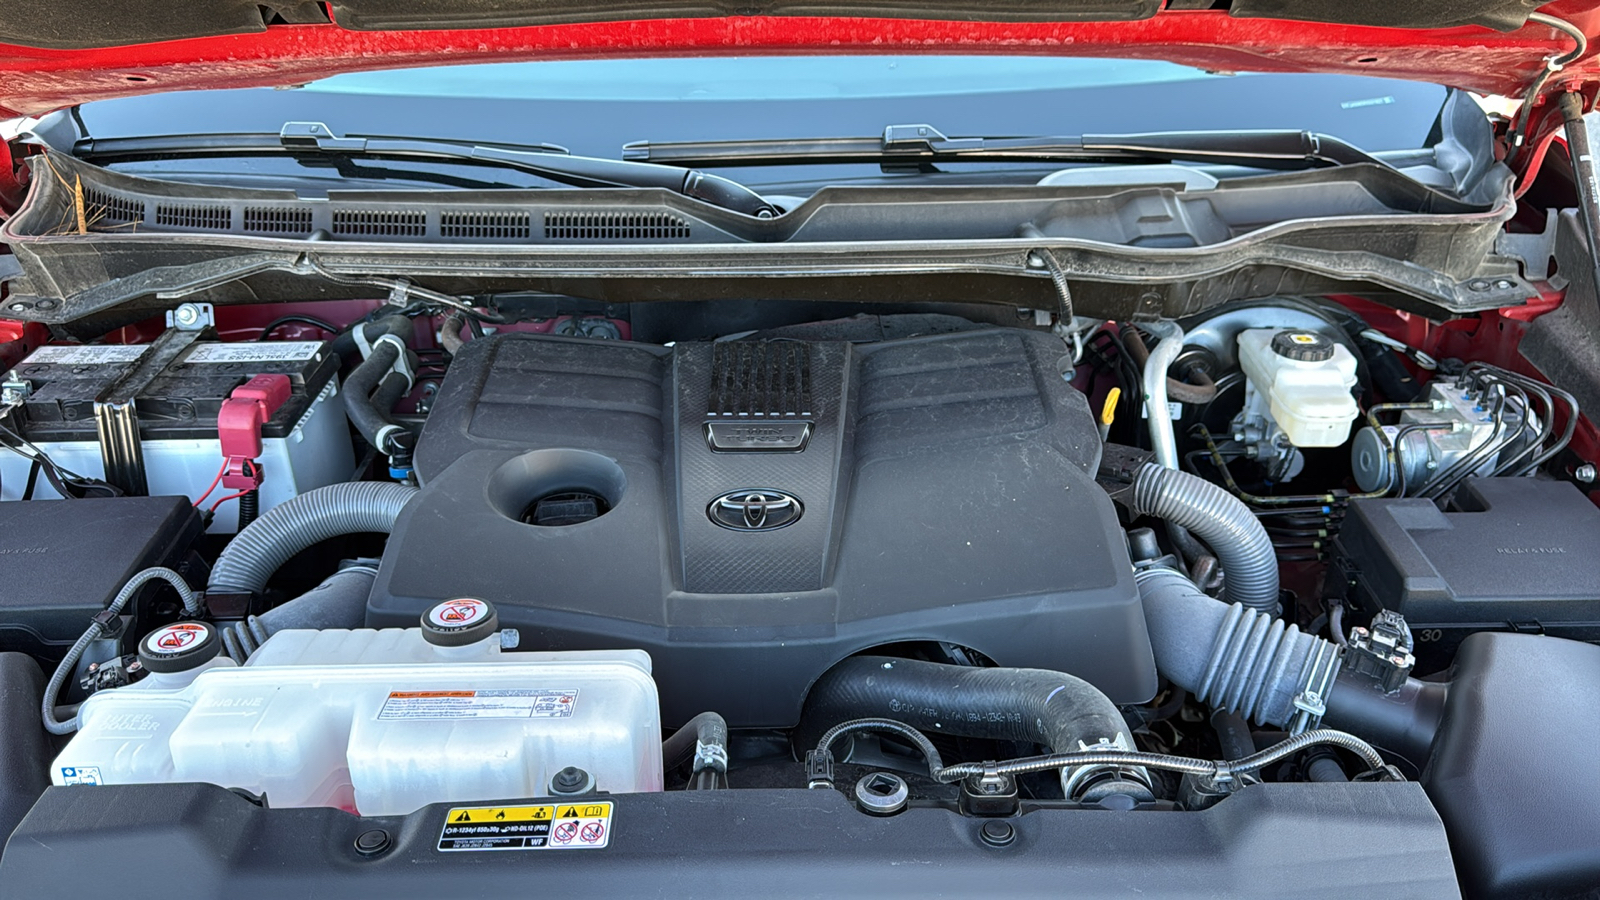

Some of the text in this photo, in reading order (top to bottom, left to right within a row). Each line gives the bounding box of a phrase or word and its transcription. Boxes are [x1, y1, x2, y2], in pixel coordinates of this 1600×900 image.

[721, 434, 796, 442] TURBO
[1420, 629, 1442, 642] 30
[203, 697, 264, 707] ENGINE
[530, 838, 544, 846] WF
